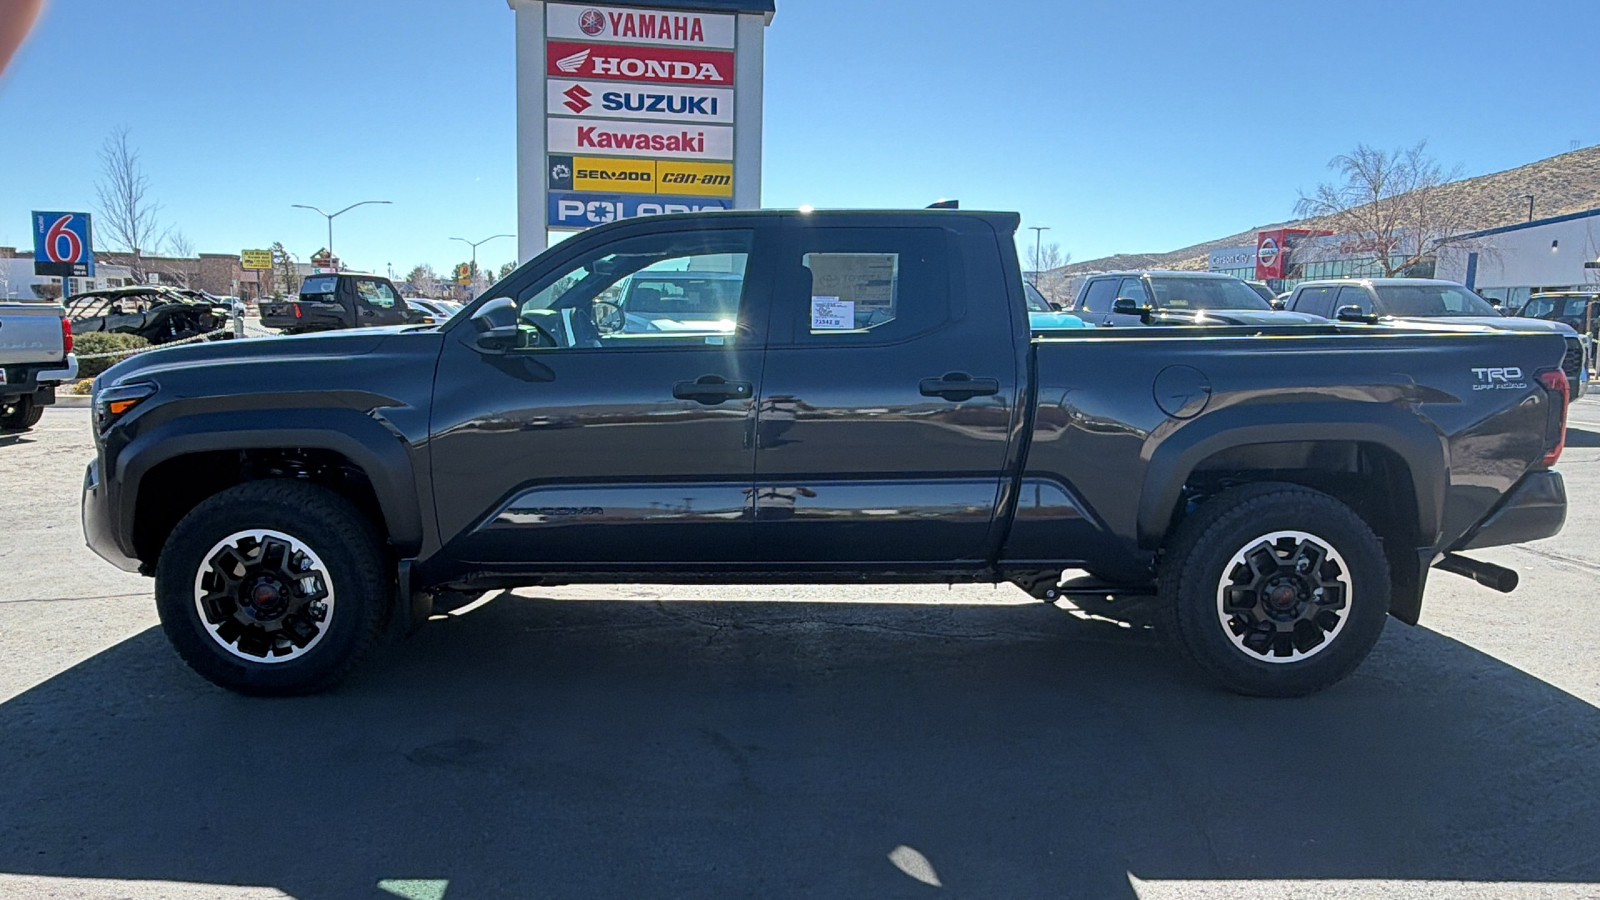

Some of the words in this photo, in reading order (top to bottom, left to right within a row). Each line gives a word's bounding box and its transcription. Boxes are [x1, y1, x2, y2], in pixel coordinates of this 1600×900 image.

[608, 12, 704, 42] YAMAHA
[592, 57, 723, 81] HONDA
[602, 92, 717, 115] SUZUKI
[577, 126, 704, 153] Kawasaki
[558, 200, 724, 222] POLA
[45, 214, 82, 263] 6
[1212, 255, 1234, 265] Carson
[1235, 253, 1248, 264] Cty
[1471, 367, 1522, 382] TRD
[508, 506, 603, 515] TACOMA
